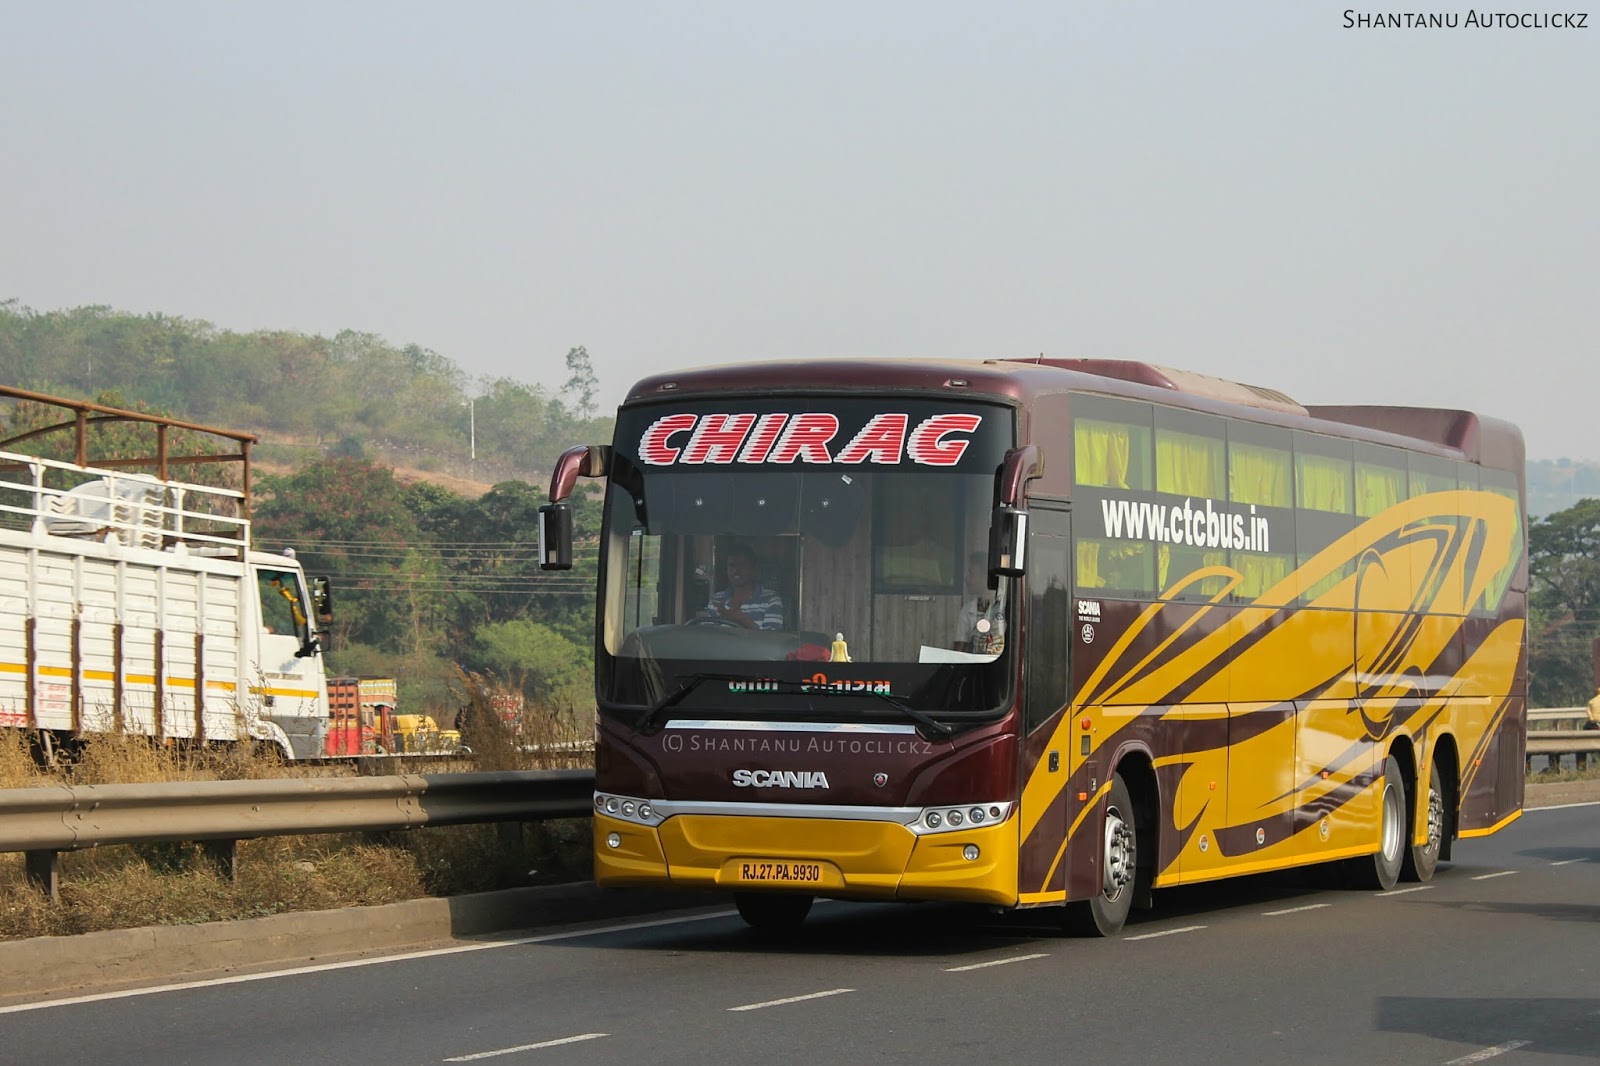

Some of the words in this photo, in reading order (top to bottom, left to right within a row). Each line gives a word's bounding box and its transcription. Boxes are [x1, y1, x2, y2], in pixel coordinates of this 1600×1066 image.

[638, 413, 982, 466] CHIRAG
[1078, 600, 1101, 616] SCANIA
[732, 769, 830, 789] SCANIA
[742, 864, 819, 881] RJ.27.PA.9930
